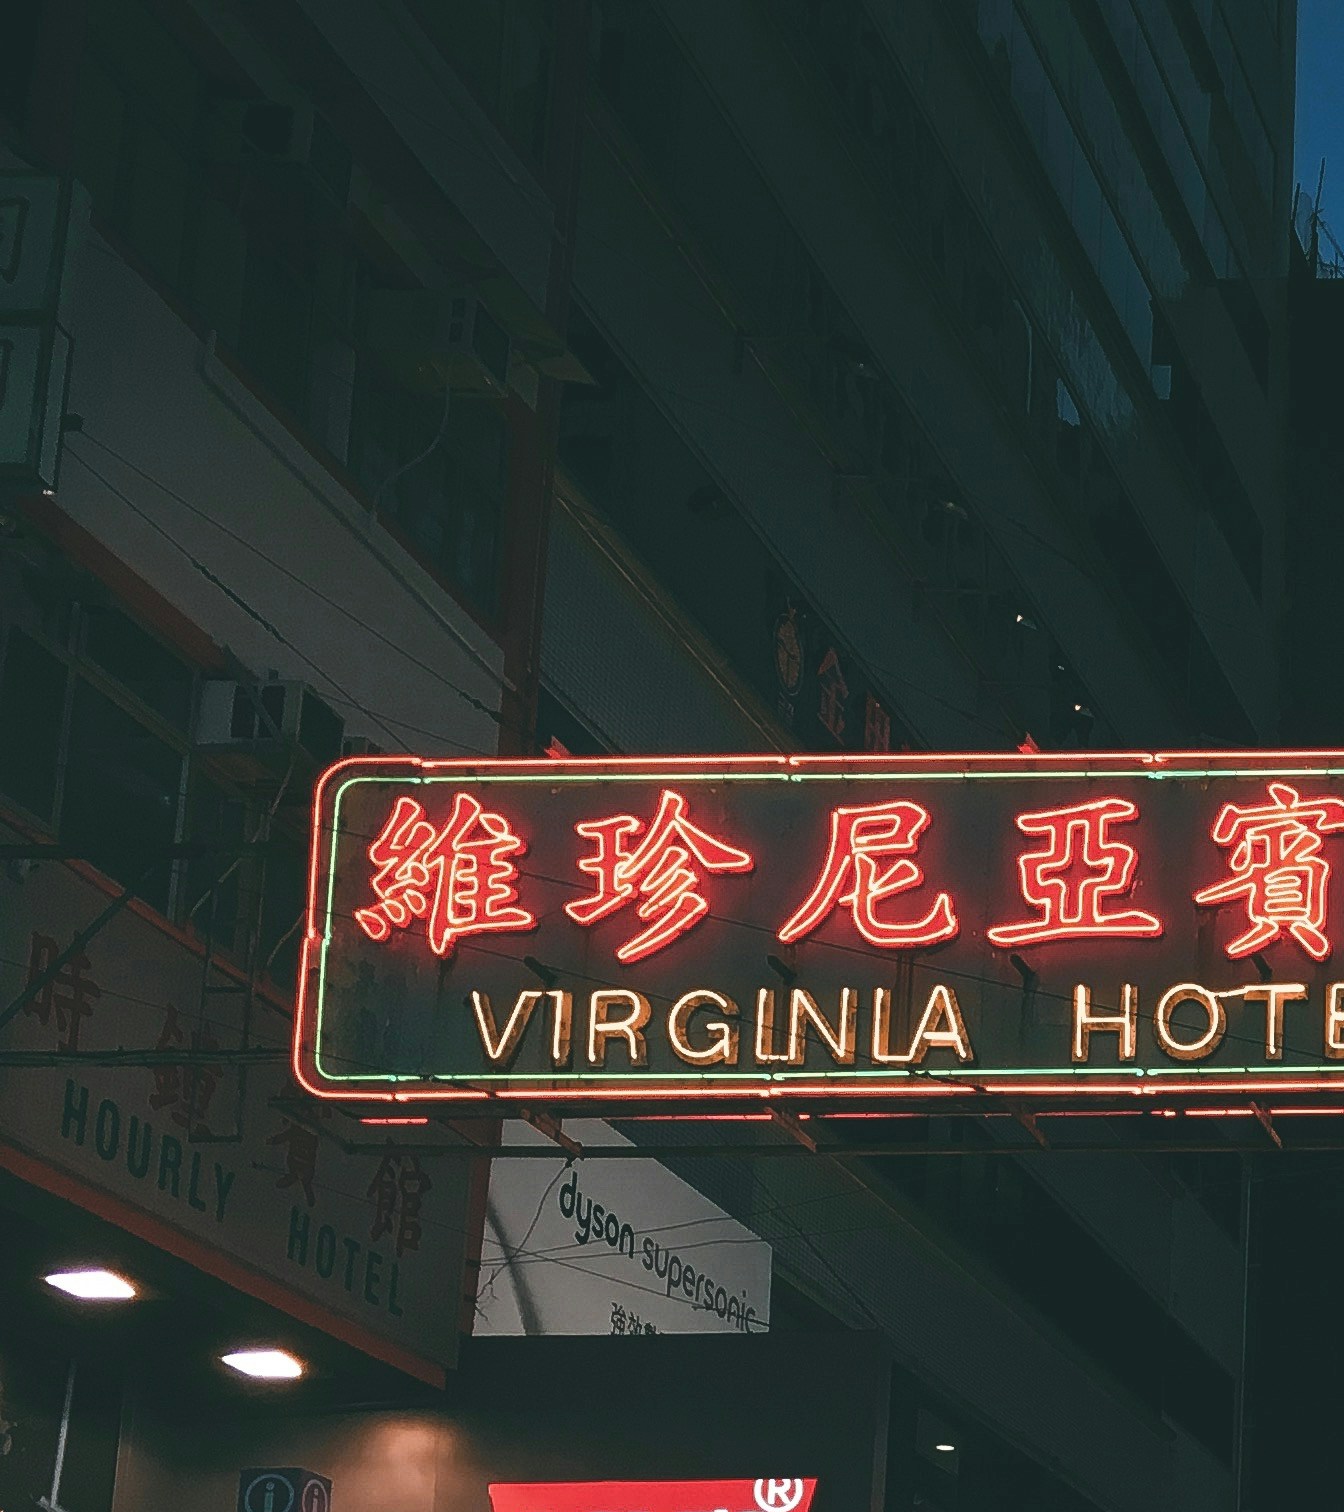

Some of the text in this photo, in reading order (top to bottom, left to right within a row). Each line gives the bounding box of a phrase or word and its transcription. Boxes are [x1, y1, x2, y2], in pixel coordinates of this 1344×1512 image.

[469, 982, 973, 1067] VIRGINIA
[60, 1078, 403, 1318] HOURLY HOTEL
[558, 1170, 757, 1334] dyson supersonic
